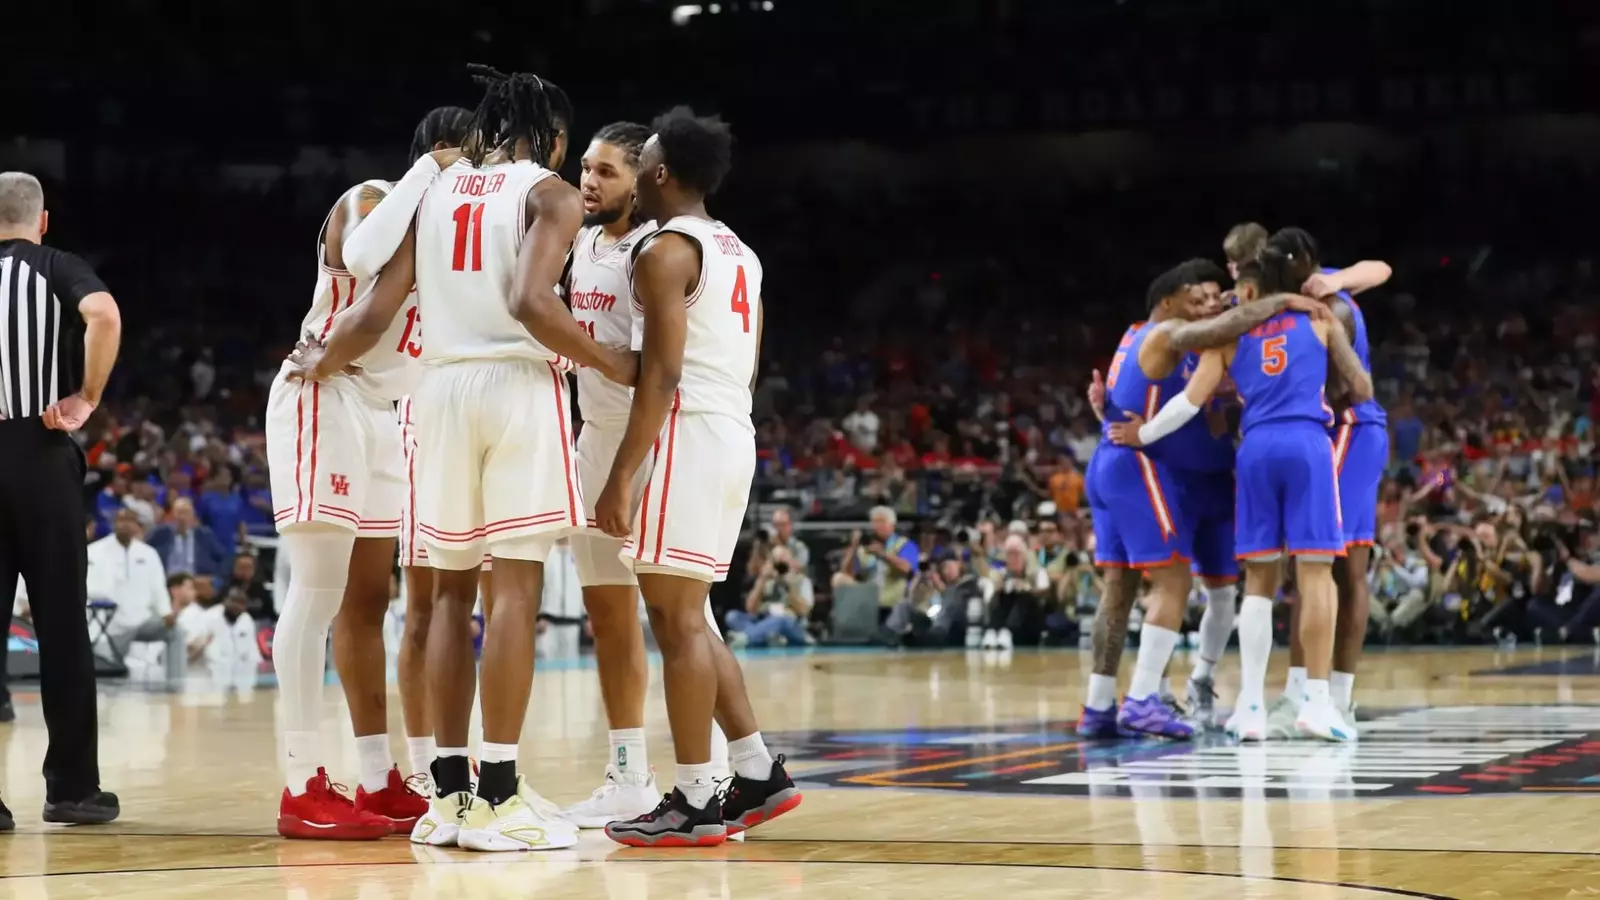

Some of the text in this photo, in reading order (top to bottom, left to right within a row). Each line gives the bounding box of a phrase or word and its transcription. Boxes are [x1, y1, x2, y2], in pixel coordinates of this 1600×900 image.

[1042, 90, 1180, 121] ROAD
[1211, 83, 1353, 115] ENDS
[1381, 75, 1535, 107] HERE
[452, 173, 506, 196] TUGLER
[452, 202, 485, 271] 11
[731, 265, 750, 333] 4
[1262, 334, 1288, 376] 5
